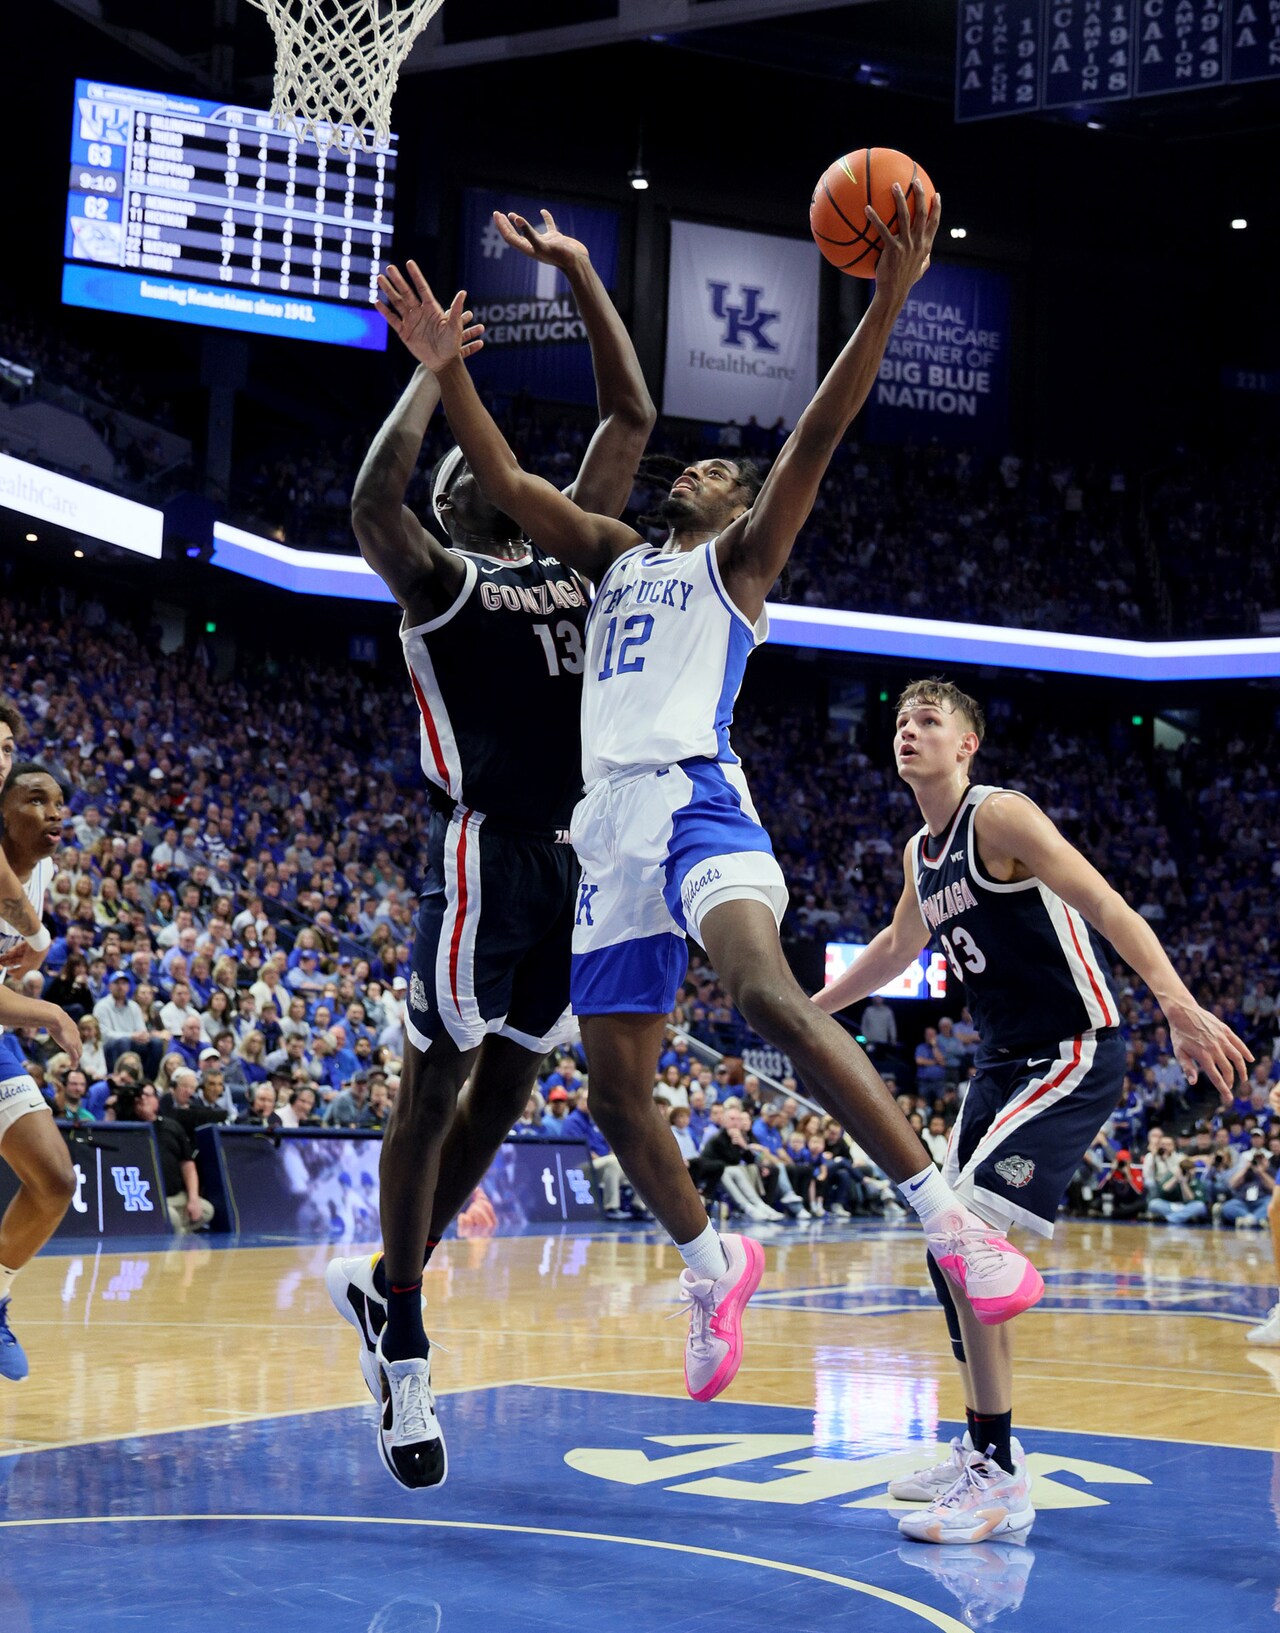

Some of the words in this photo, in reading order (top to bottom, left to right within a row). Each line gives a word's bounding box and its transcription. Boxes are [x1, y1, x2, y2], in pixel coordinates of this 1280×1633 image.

[962, 3, 984, 91] NCAA
[1082, 0, 1102, 92] HAMPION
[1107, 4, 1129, 91] 1948
[1142, 0, 1164, 64] CAA
[1174, 0, 1195, 78] AMPION
[1235, 3, 1259, 48] AA
[1015, 17, 1036, 104] 1942
[475, 301, 573, 323] HOSPITAL
[705, 279, 779, 354] UK
[893, 318, 1000, 350] EALTHCARE
[902, 300, 966, 325] FICIAL
[690, 350, 796, 381] HealthCare
[880, 358, 921, 384] BIG
[928, 365, 990, 393] BLUE
[887, 340, 962, 364] ARTNER
[966, 348, 994, 367] OF
[878, 384, 977, 416] NATION
[0, 473, 78, 518] ealthCare
[600, 579, 694, 614] ENUCKY
[532, 620, 585, 677] 13
[598, 613, 655, 681] 12
[683, 867, 722, 916] Wildcats
[922, 877, 979, 930] ONZAGA
[940, 926, 986, 982] 33
[0, 1083, 31, 1100] ldcats
[111, 1166, 154, 1212] UK
